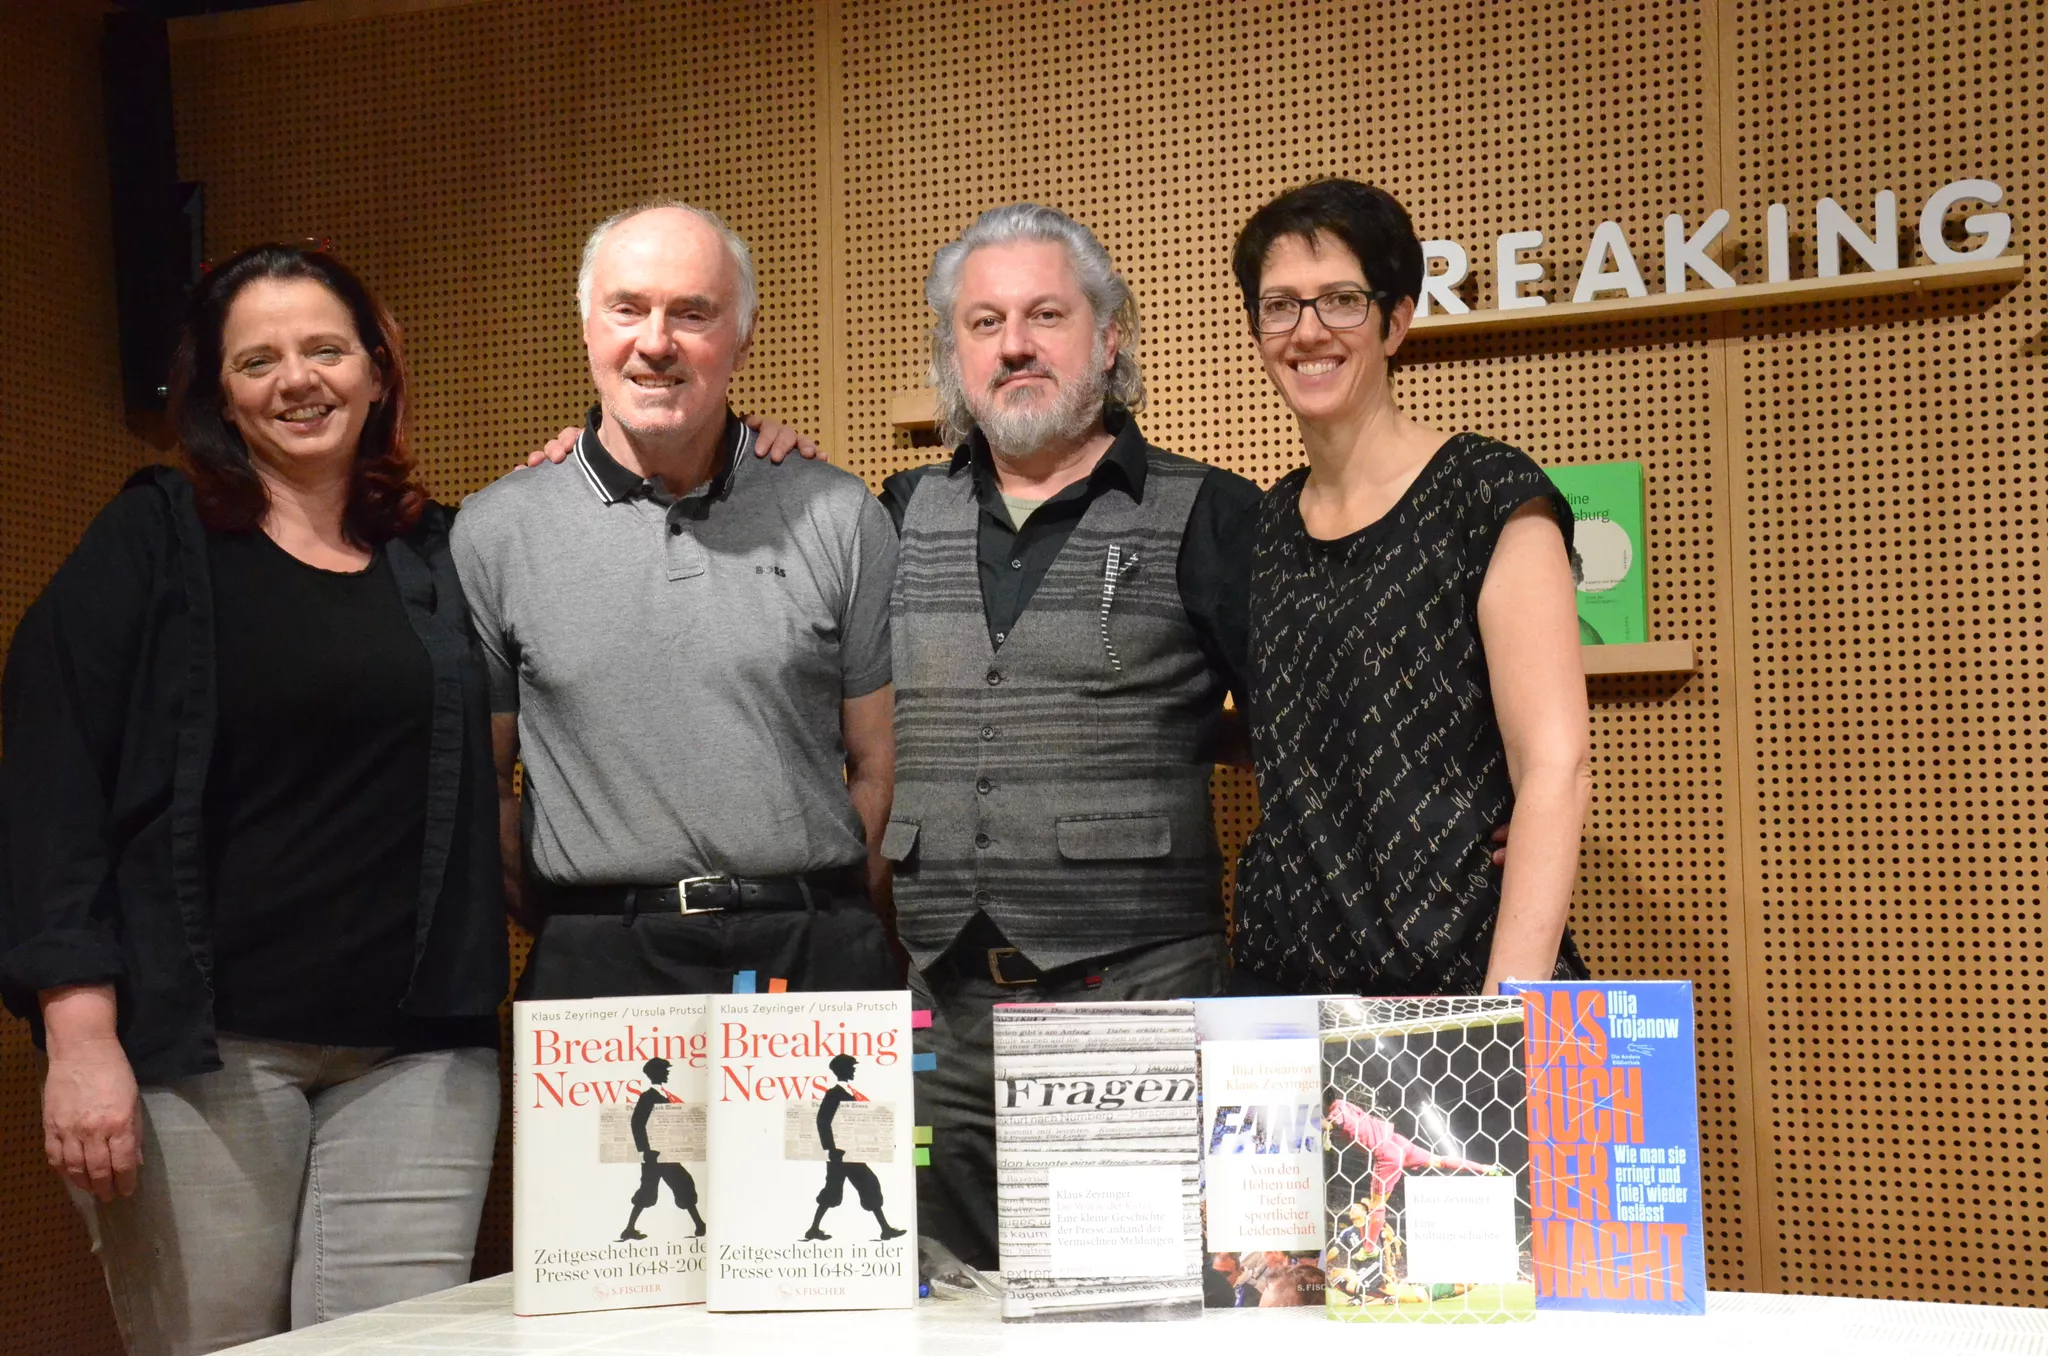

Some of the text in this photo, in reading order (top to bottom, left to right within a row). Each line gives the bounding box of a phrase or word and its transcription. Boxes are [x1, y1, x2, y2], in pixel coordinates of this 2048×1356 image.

[1414, 178, 2011, 317] REAKING
[1363, 624, 1407, 676] Show
[1362, 704, 1382, 723] my
[1383, 645, 1431, 709] perfect
[1351, 744, 1384, 797] Show
[1389, 670, 1454, 749] yourself
[1414, 726, 1448, 766] what
[1392, 752, 1414, 788] your
[1362, 787, 1397, 834] heart
[1368, 830, 1402, 882] Show
[1407, 754, 1463, 833] yourself
[1351, 926, 1368, 945] to
[1383, 848, 1429, 914] perfect
[1395, 870, 1453, 949] yourself
[1454, 832, 1483, 869] more
[1423, 922, 1453, 961] what
[531, 1011, 561, 1022] Klaus
[564, 1009, 619, 1023] Zeyringer
[631, 1006, 666, 1017] Ursula
[719, 1002, 749, 1014] Klaus
[751, 1002, 806, 1016] Zeyringer
[818, 1001, 853, 1013] Ursula
[855, 1000, 898, 1012] Prutsch
[1607, 990, 1637, 1017] Ilija
[1524, 990, 1608, 1067] DAS
[1608, 1014, 1679, 1041] Trojanow
[530, 1025, 708, 1069] Breaking
[719, 1020, 899, 1066] Breaking
[720, 1064, 829, 1102] News
[1258, 1063, 1314, 1076] Trojanow
[531, 1071, 644, 1109] News
[1001, 1078, 1197, 1110] Fragen
[1225, 1079, 1260, 1091] Klaus
[1526, 1067, 1645, 1144] BUCH
[1614, 1144, 1687, 1164] Wie man sie
[1251, 1162, 1301, 1175] Von den
[1529, 1143, 1611, 1221] DER
[1615, 1165, 1681, 1185] erringt und
[1056, 1189, 1131, 1202] Klaus Zeyringer
[1286, 1177, 1310, 1190] und
[1616, 1184, 1688, 1203] (nie) wieder
[1259, 1193, 1296, 1206] Tiefen
[1617, 1202, 1665, 1222] loslässt
[1057, 1211, 1166, 1223] Eine kleine Geschichte
[1057, 1223, 1162, 1235] der Presse anhand der
[1244, 1207, 1310, 1224] sportlicher
[1010, 1229, 1048, 1239] kaum
[1057, 1236, 1117, 1247] Vermischten
[1119, 1235, 1174, 1247] Meldungen
[1239, 1222, 1316, 1237] Leidenschaft
[534, 1238, 707, 1267] Zeitgeschehen in de
[719, 1242, 904, 1264] Zeitgeschehen in der
[1532, 1220, 1688, 1302] MACHT
[535, 1257, 707, 1284] Presse von 1648-200
[720, 1261, 903, 1280] Presse von 1648-2001
[1008, 1288, 1095, 1301] Jugendliche
[1098, 1283, 1160, 1295] zwischen
